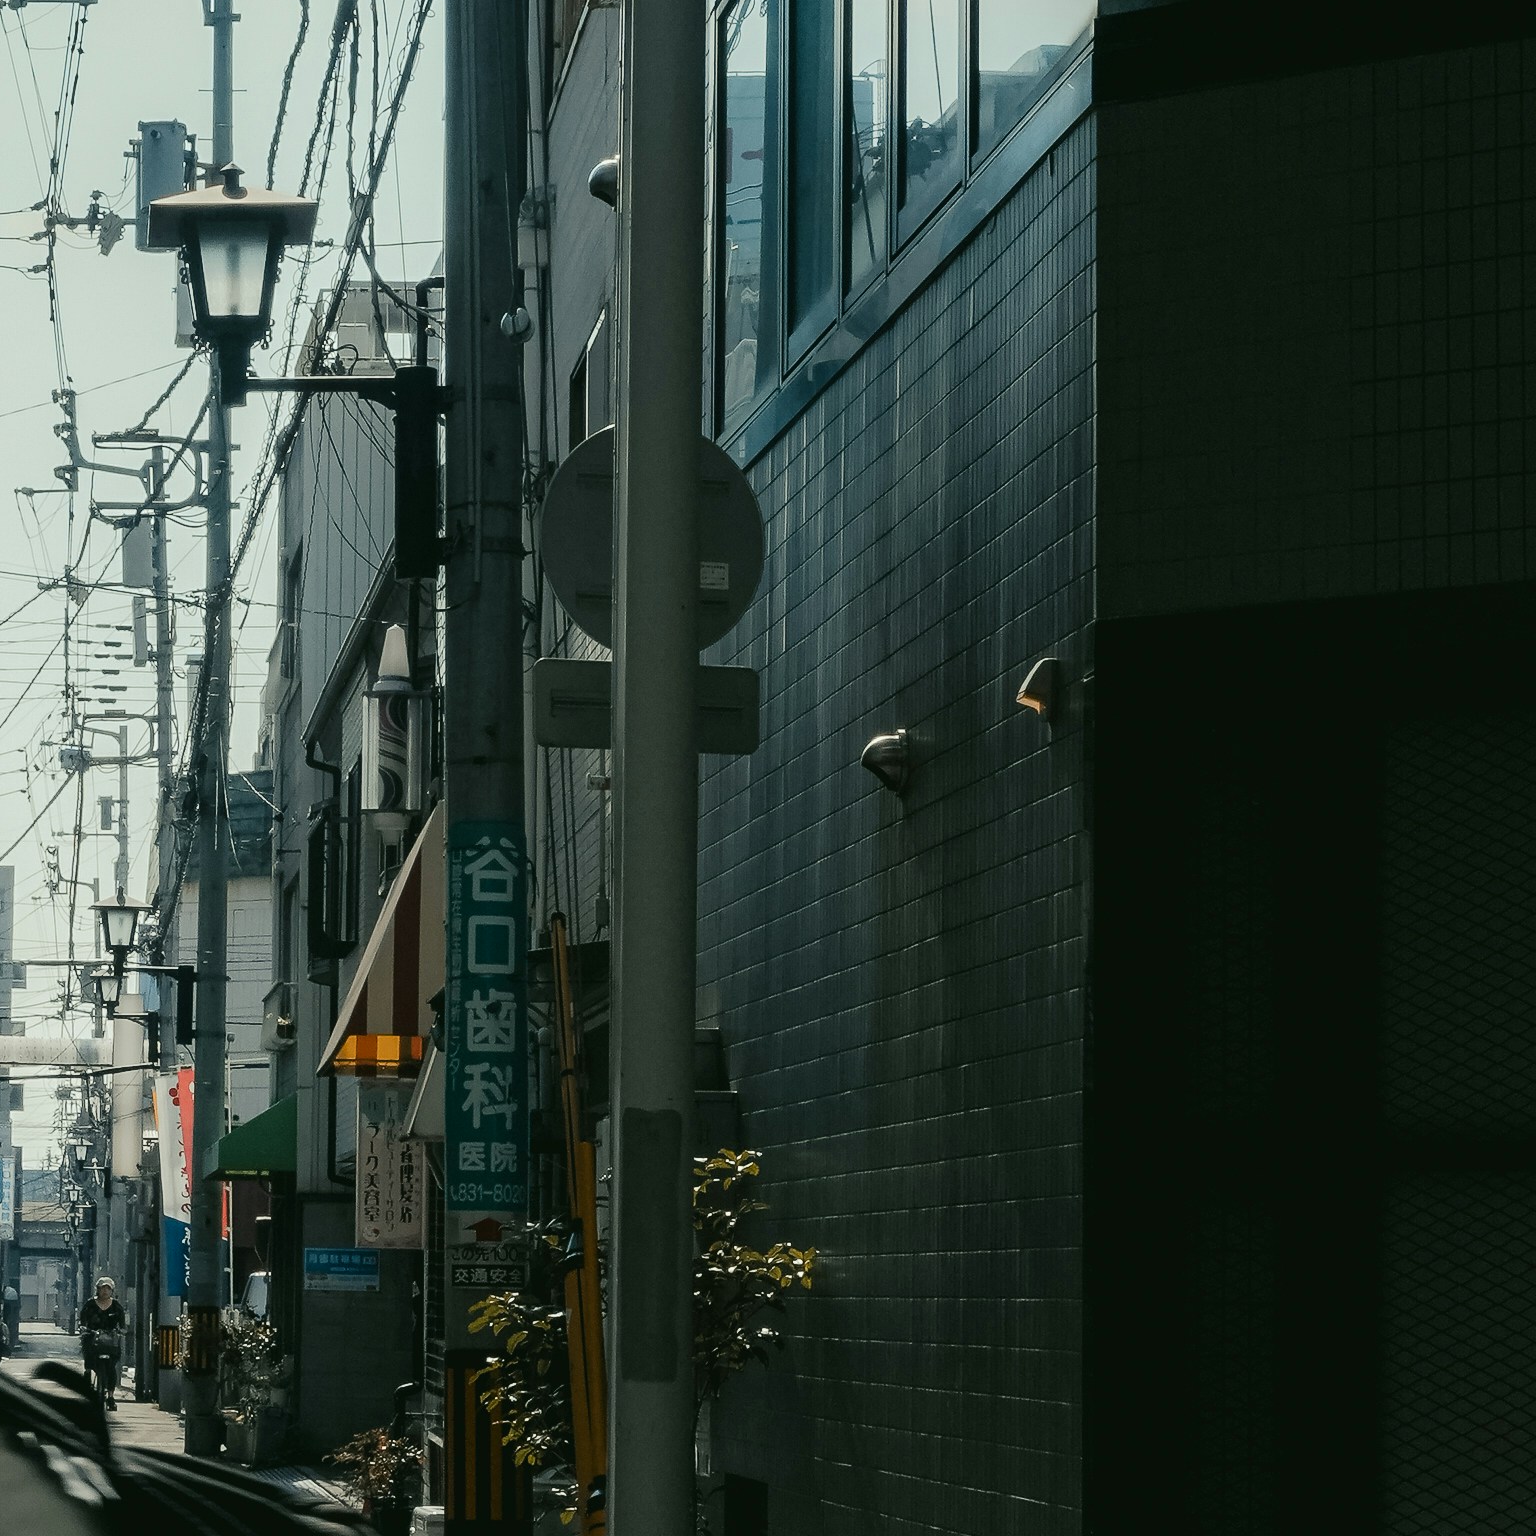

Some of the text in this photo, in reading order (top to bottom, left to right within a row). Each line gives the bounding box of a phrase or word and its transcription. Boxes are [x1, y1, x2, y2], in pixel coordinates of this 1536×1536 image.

[462, 836, 519, 1130] 谷口歯科
[458, 1141, 517, 1173] 医院
[454, 1268, 522, 1284] 交通安全
